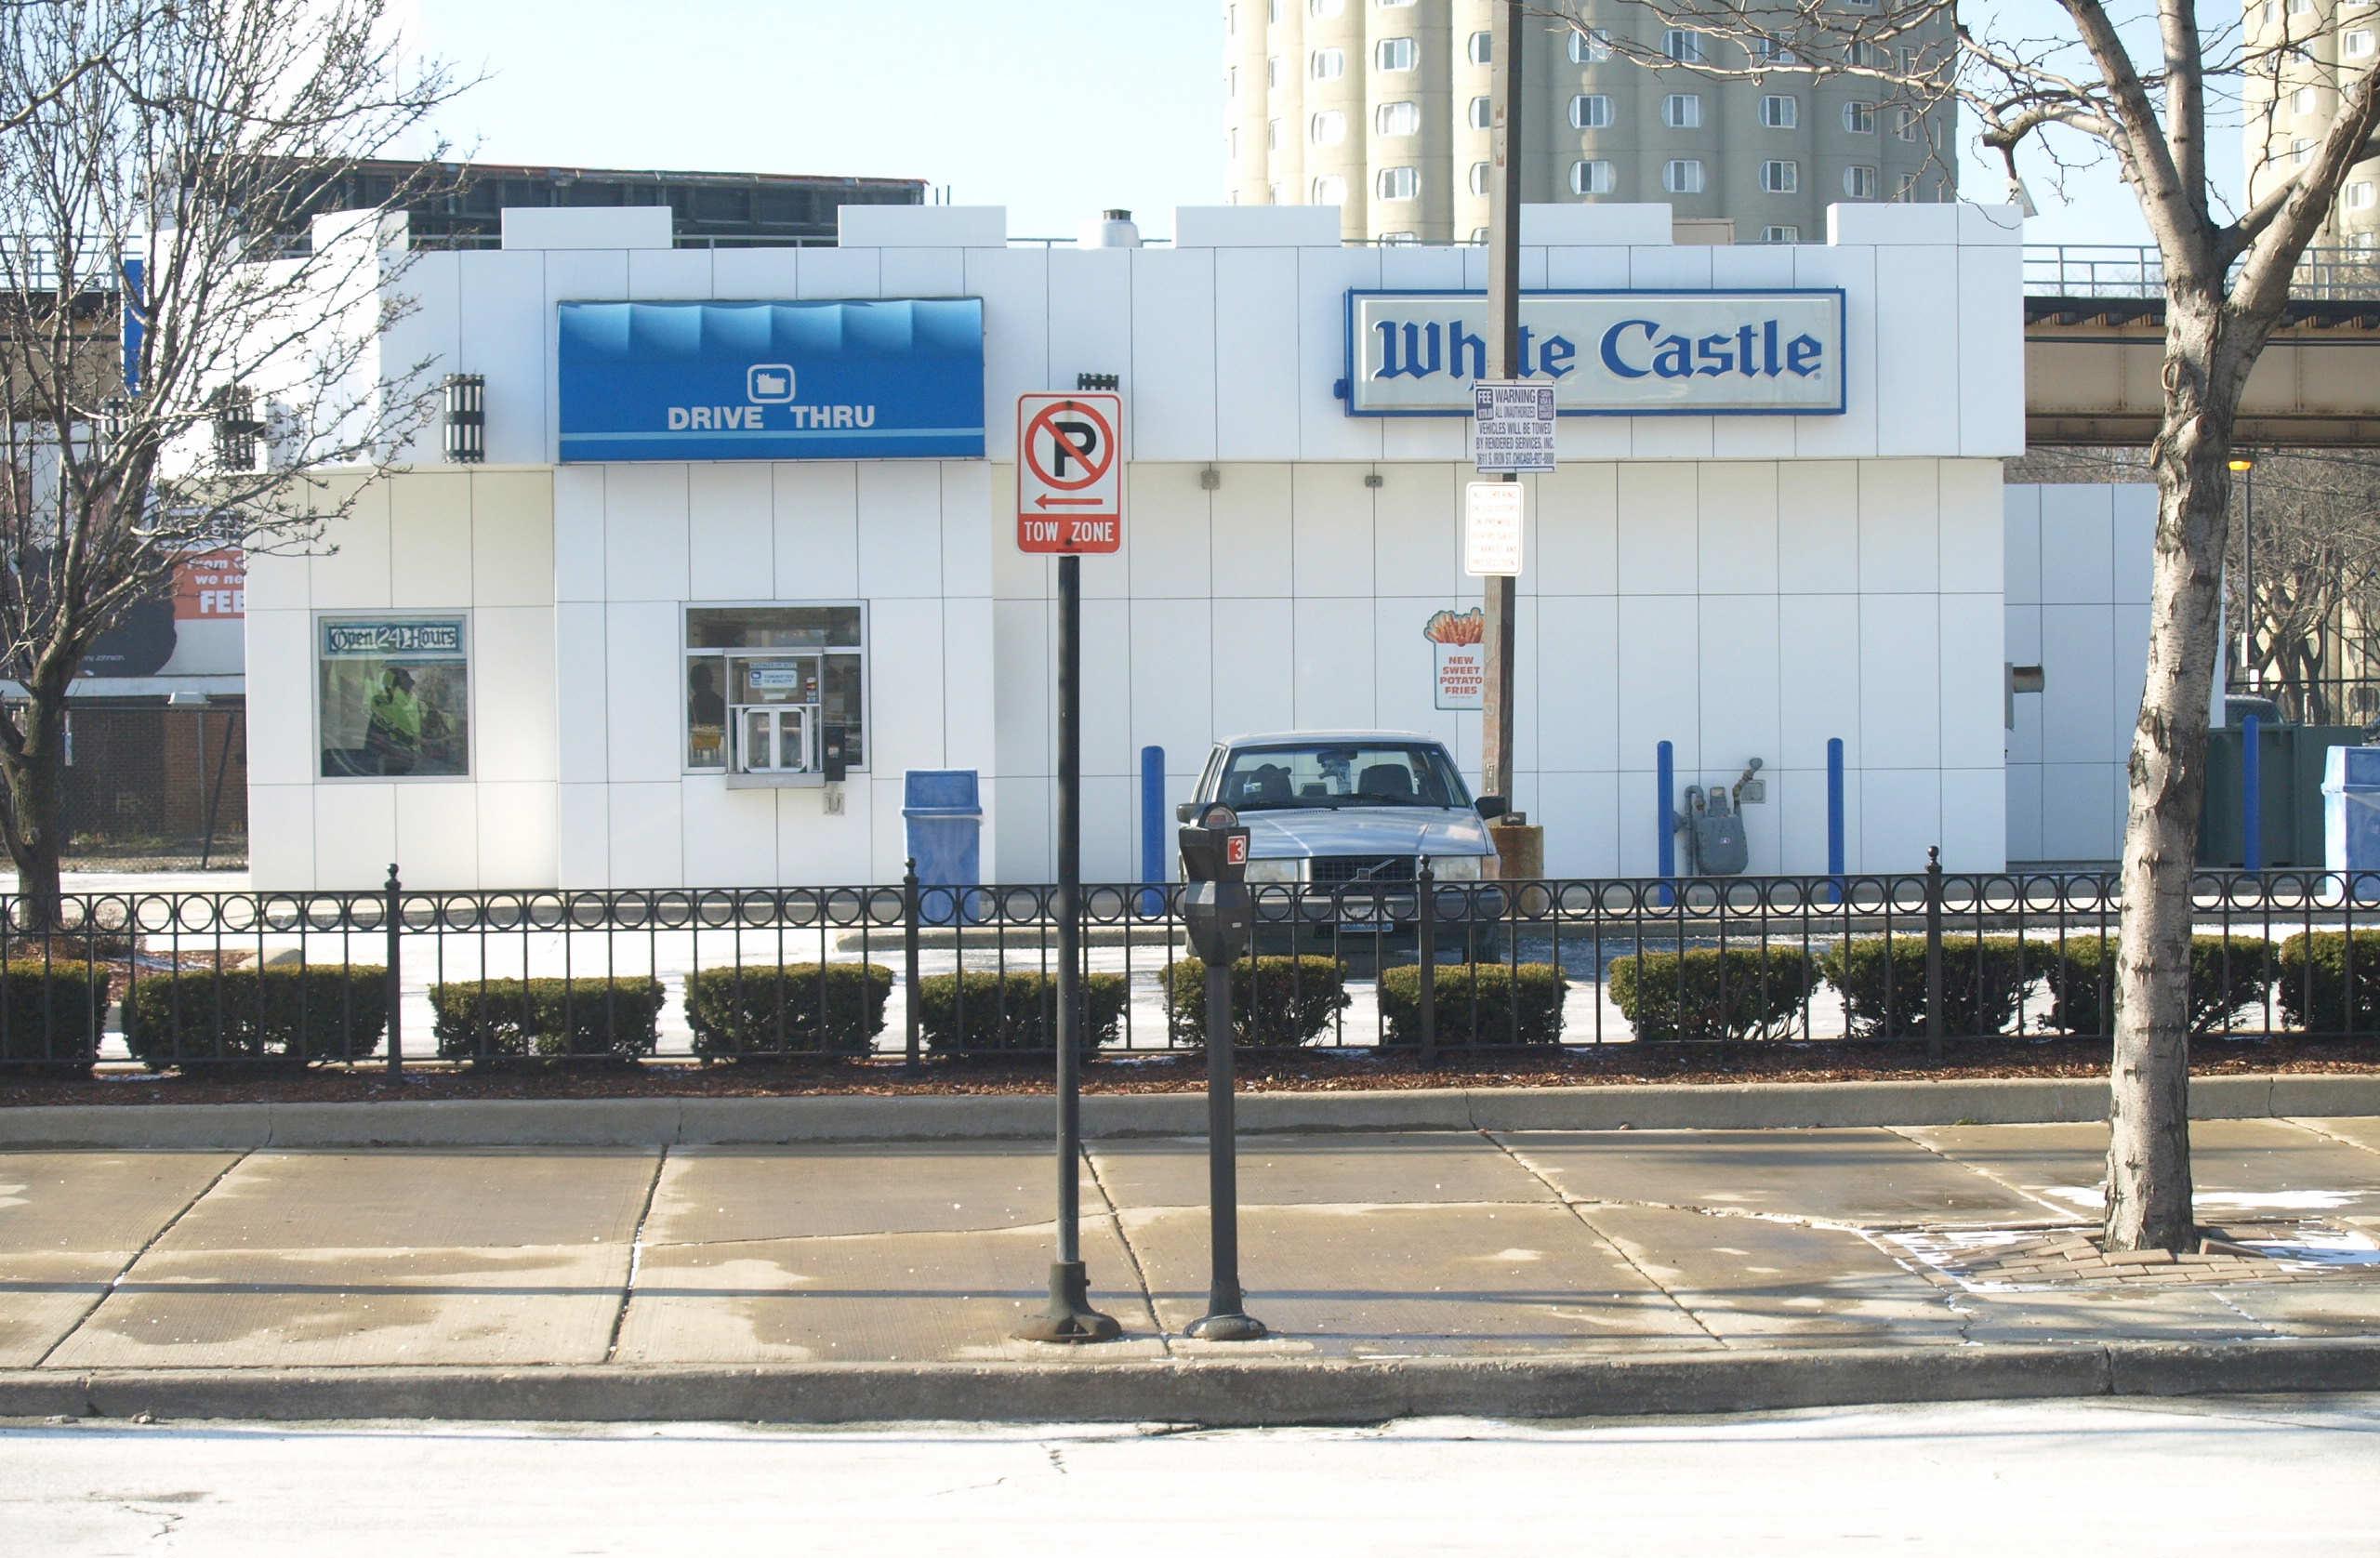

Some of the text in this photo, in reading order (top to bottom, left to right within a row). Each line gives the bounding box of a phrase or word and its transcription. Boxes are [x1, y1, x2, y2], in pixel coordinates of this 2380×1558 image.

[1372, 319, 1823, 390] Whte Castle
[1477, 390, 1492, 403] FEE
[1495, 389, 1536, 403] WARNING
[668, 404, 876, 430] DRIVE THRU
[1479, 422, 1553, 434] VEHICLES WILL BE TOWED
[1475, 437, 1484, 449] BY
[1485, 437, 1514, 449] RENDERED
[1024, 522, 1115, 542] TOW ZONE
[332, 627, 456, 650] Open 24 Hours
[1448, 655, 1474, 665] NEW
[1442, 667, 1480, 675] SWEET
[1439, 676, 1483, 685] POTATO
[1445, 686, 1478, 694] FRIES
[1234, 838, 1244, 861] 3
